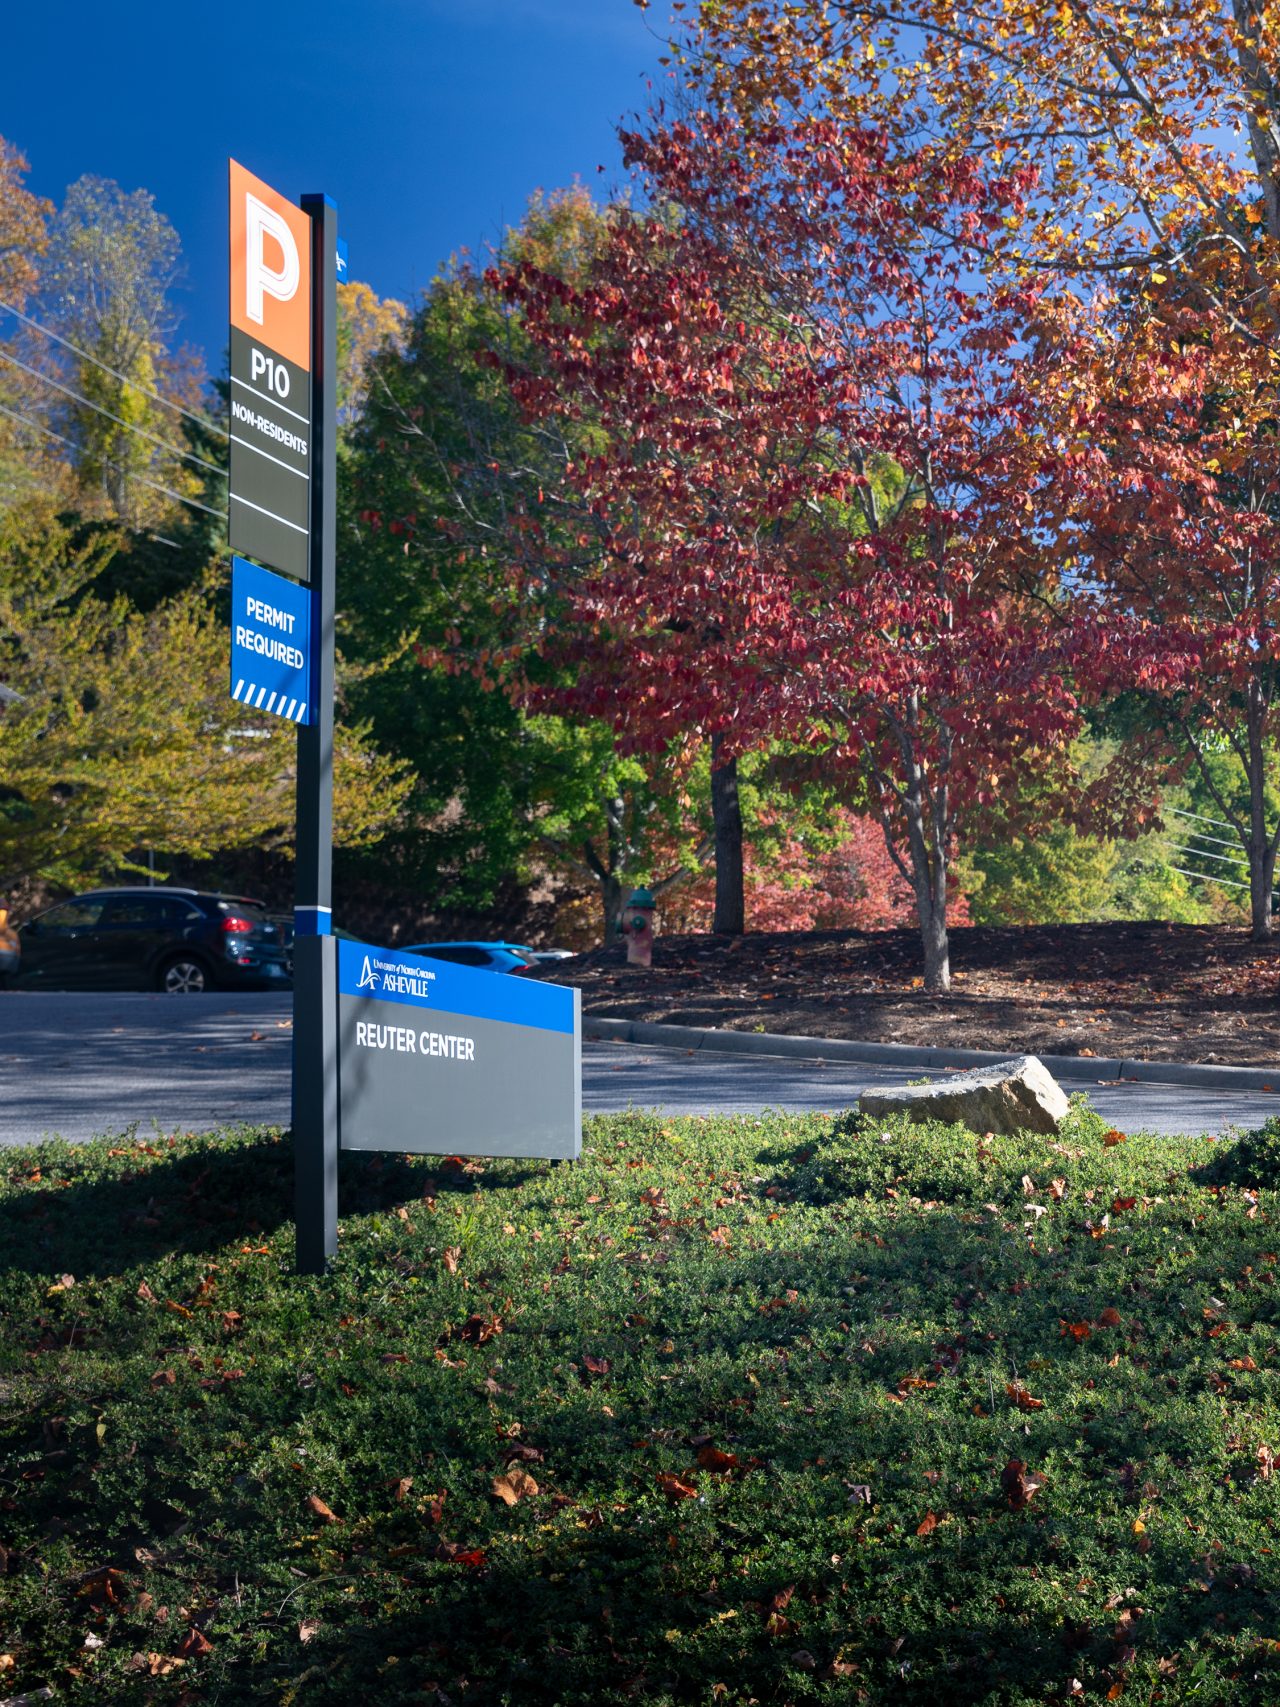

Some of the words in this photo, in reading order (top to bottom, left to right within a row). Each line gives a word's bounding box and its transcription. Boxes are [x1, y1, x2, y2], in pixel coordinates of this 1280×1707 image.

[246, 191, 300, 326] P
[251, 347, 291, 398] P10
[232, 401, 308, 456] NON-RESIDENTS
[246, 596, 296, 634] PERMIT
[236, 625, 304, 670] REQUIRED
[383, 973, 428, 997] ASHEVILLE
[356, 1021, 416, 1053] REUTER
[419, 1031, 475, 1061] CENTER
